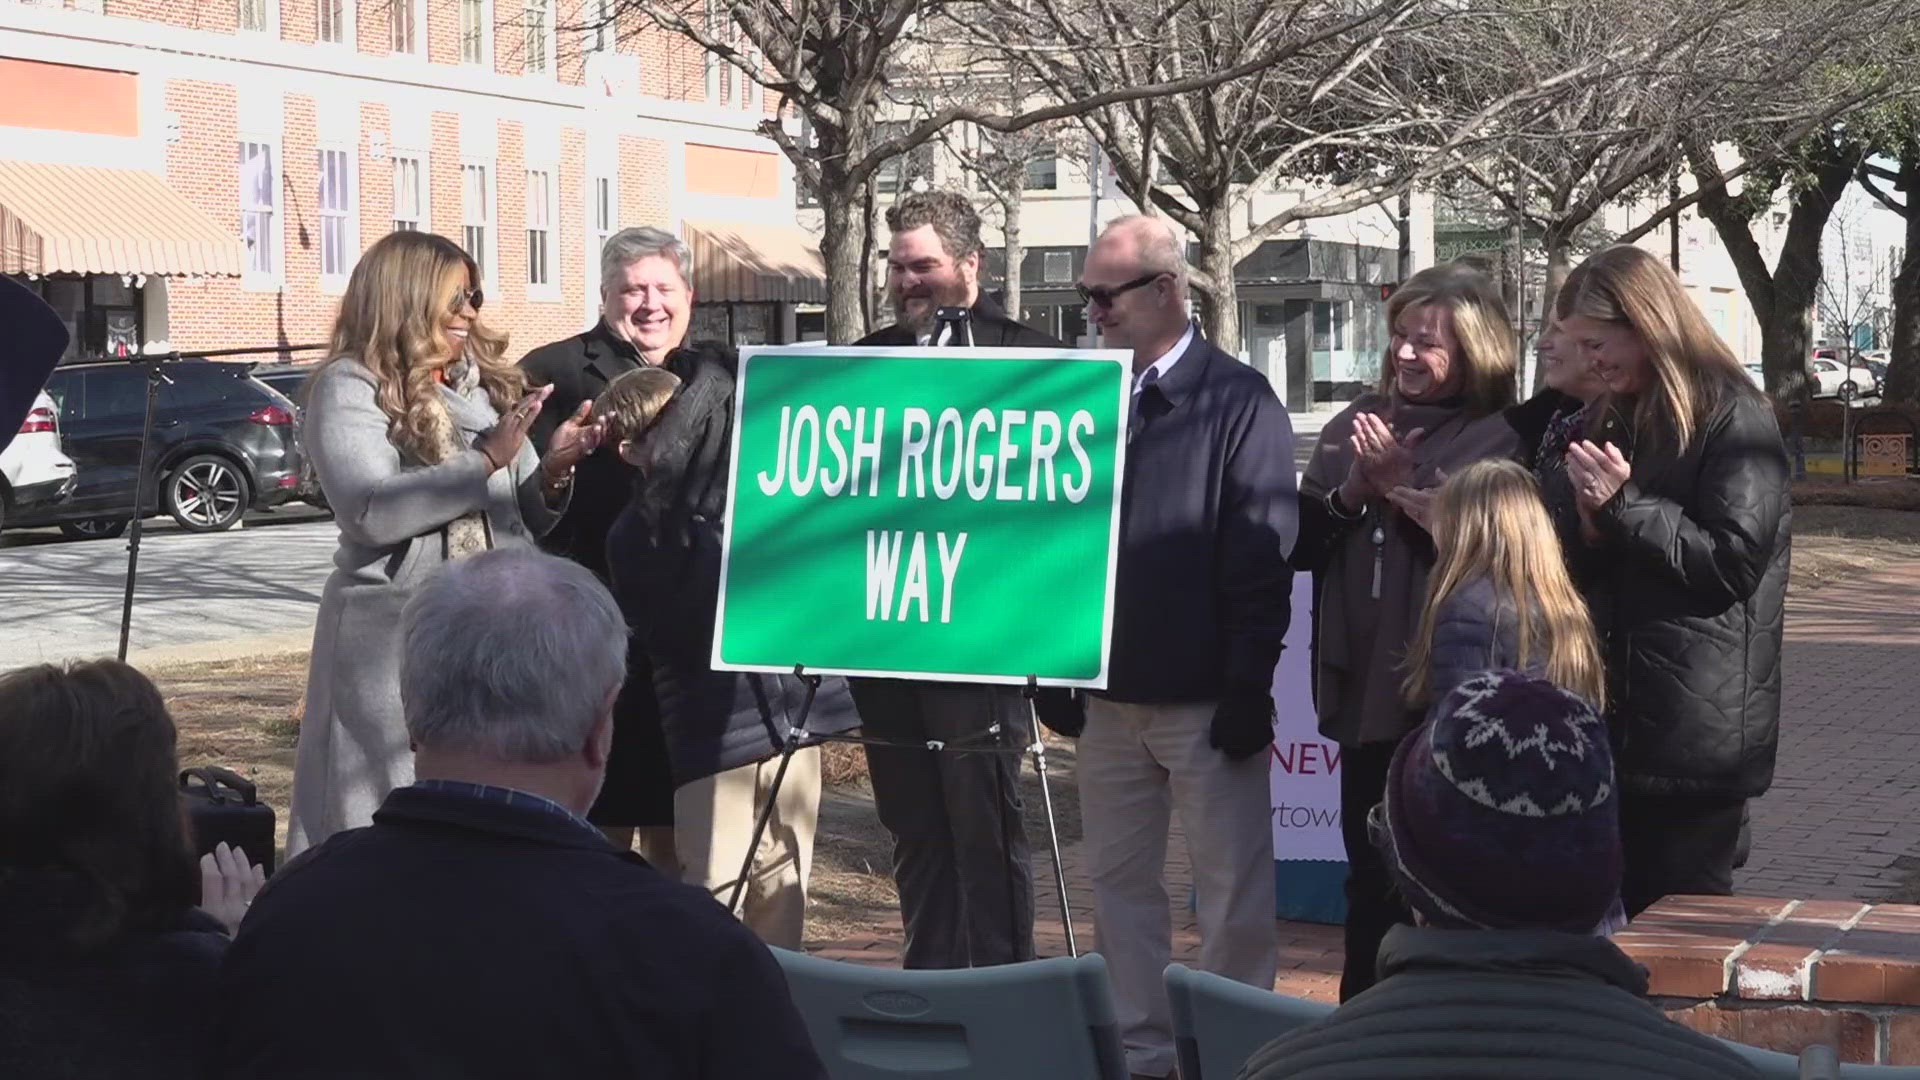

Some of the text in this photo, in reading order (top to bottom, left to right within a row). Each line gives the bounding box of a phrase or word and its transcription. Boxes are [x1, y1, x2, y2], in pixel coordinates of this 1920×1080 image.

[757, 405, 1095, 503] JOSH ROGERS
[866, 530, 967, 623] WAY
[1272, 801, 1342, 828] tow
